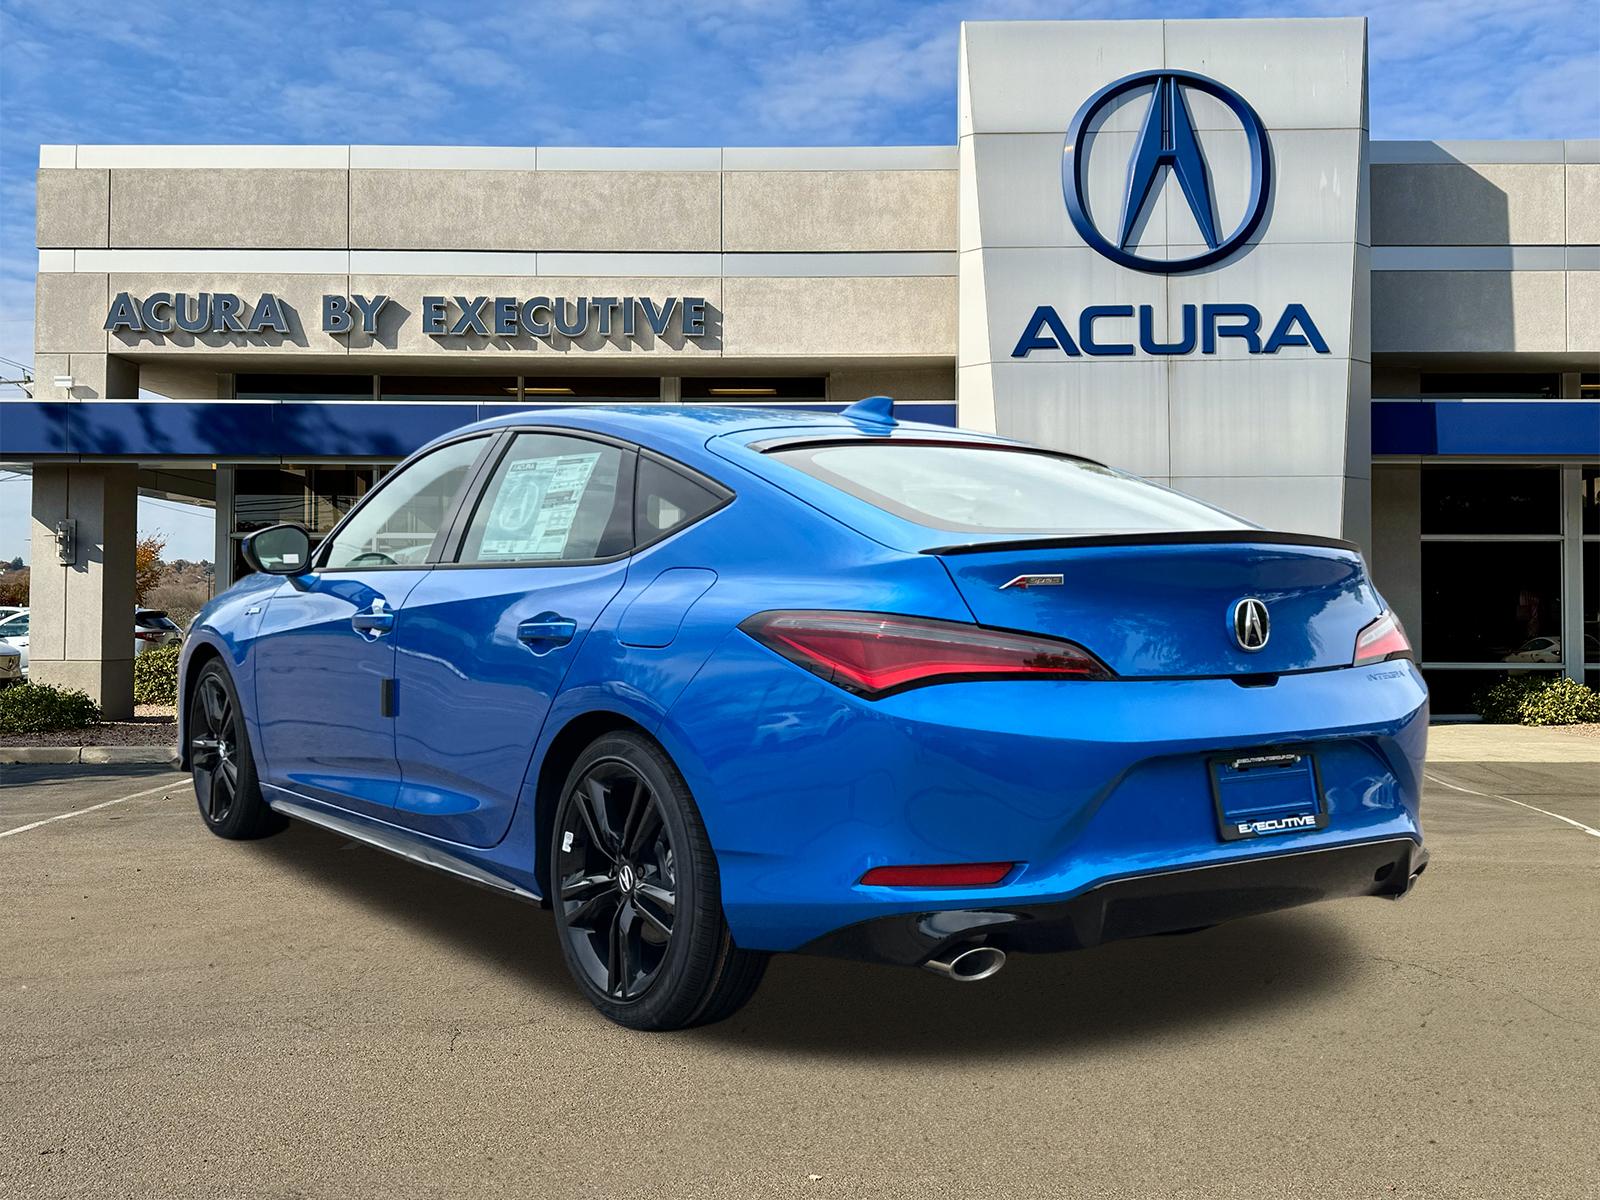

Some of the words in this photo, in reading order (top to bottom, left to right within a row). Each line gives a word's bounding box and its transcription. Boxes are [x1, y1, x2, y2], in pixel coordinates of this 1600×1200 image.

[103, 291, 290, 334] ACURA
[322, 294, 391, 334] BY
[422, 296, 706, 337] EXECUTIVE
[1011, 303, 1332, 357] ACURA
[1238, 815, 1316, 834] EXECUTIVE
